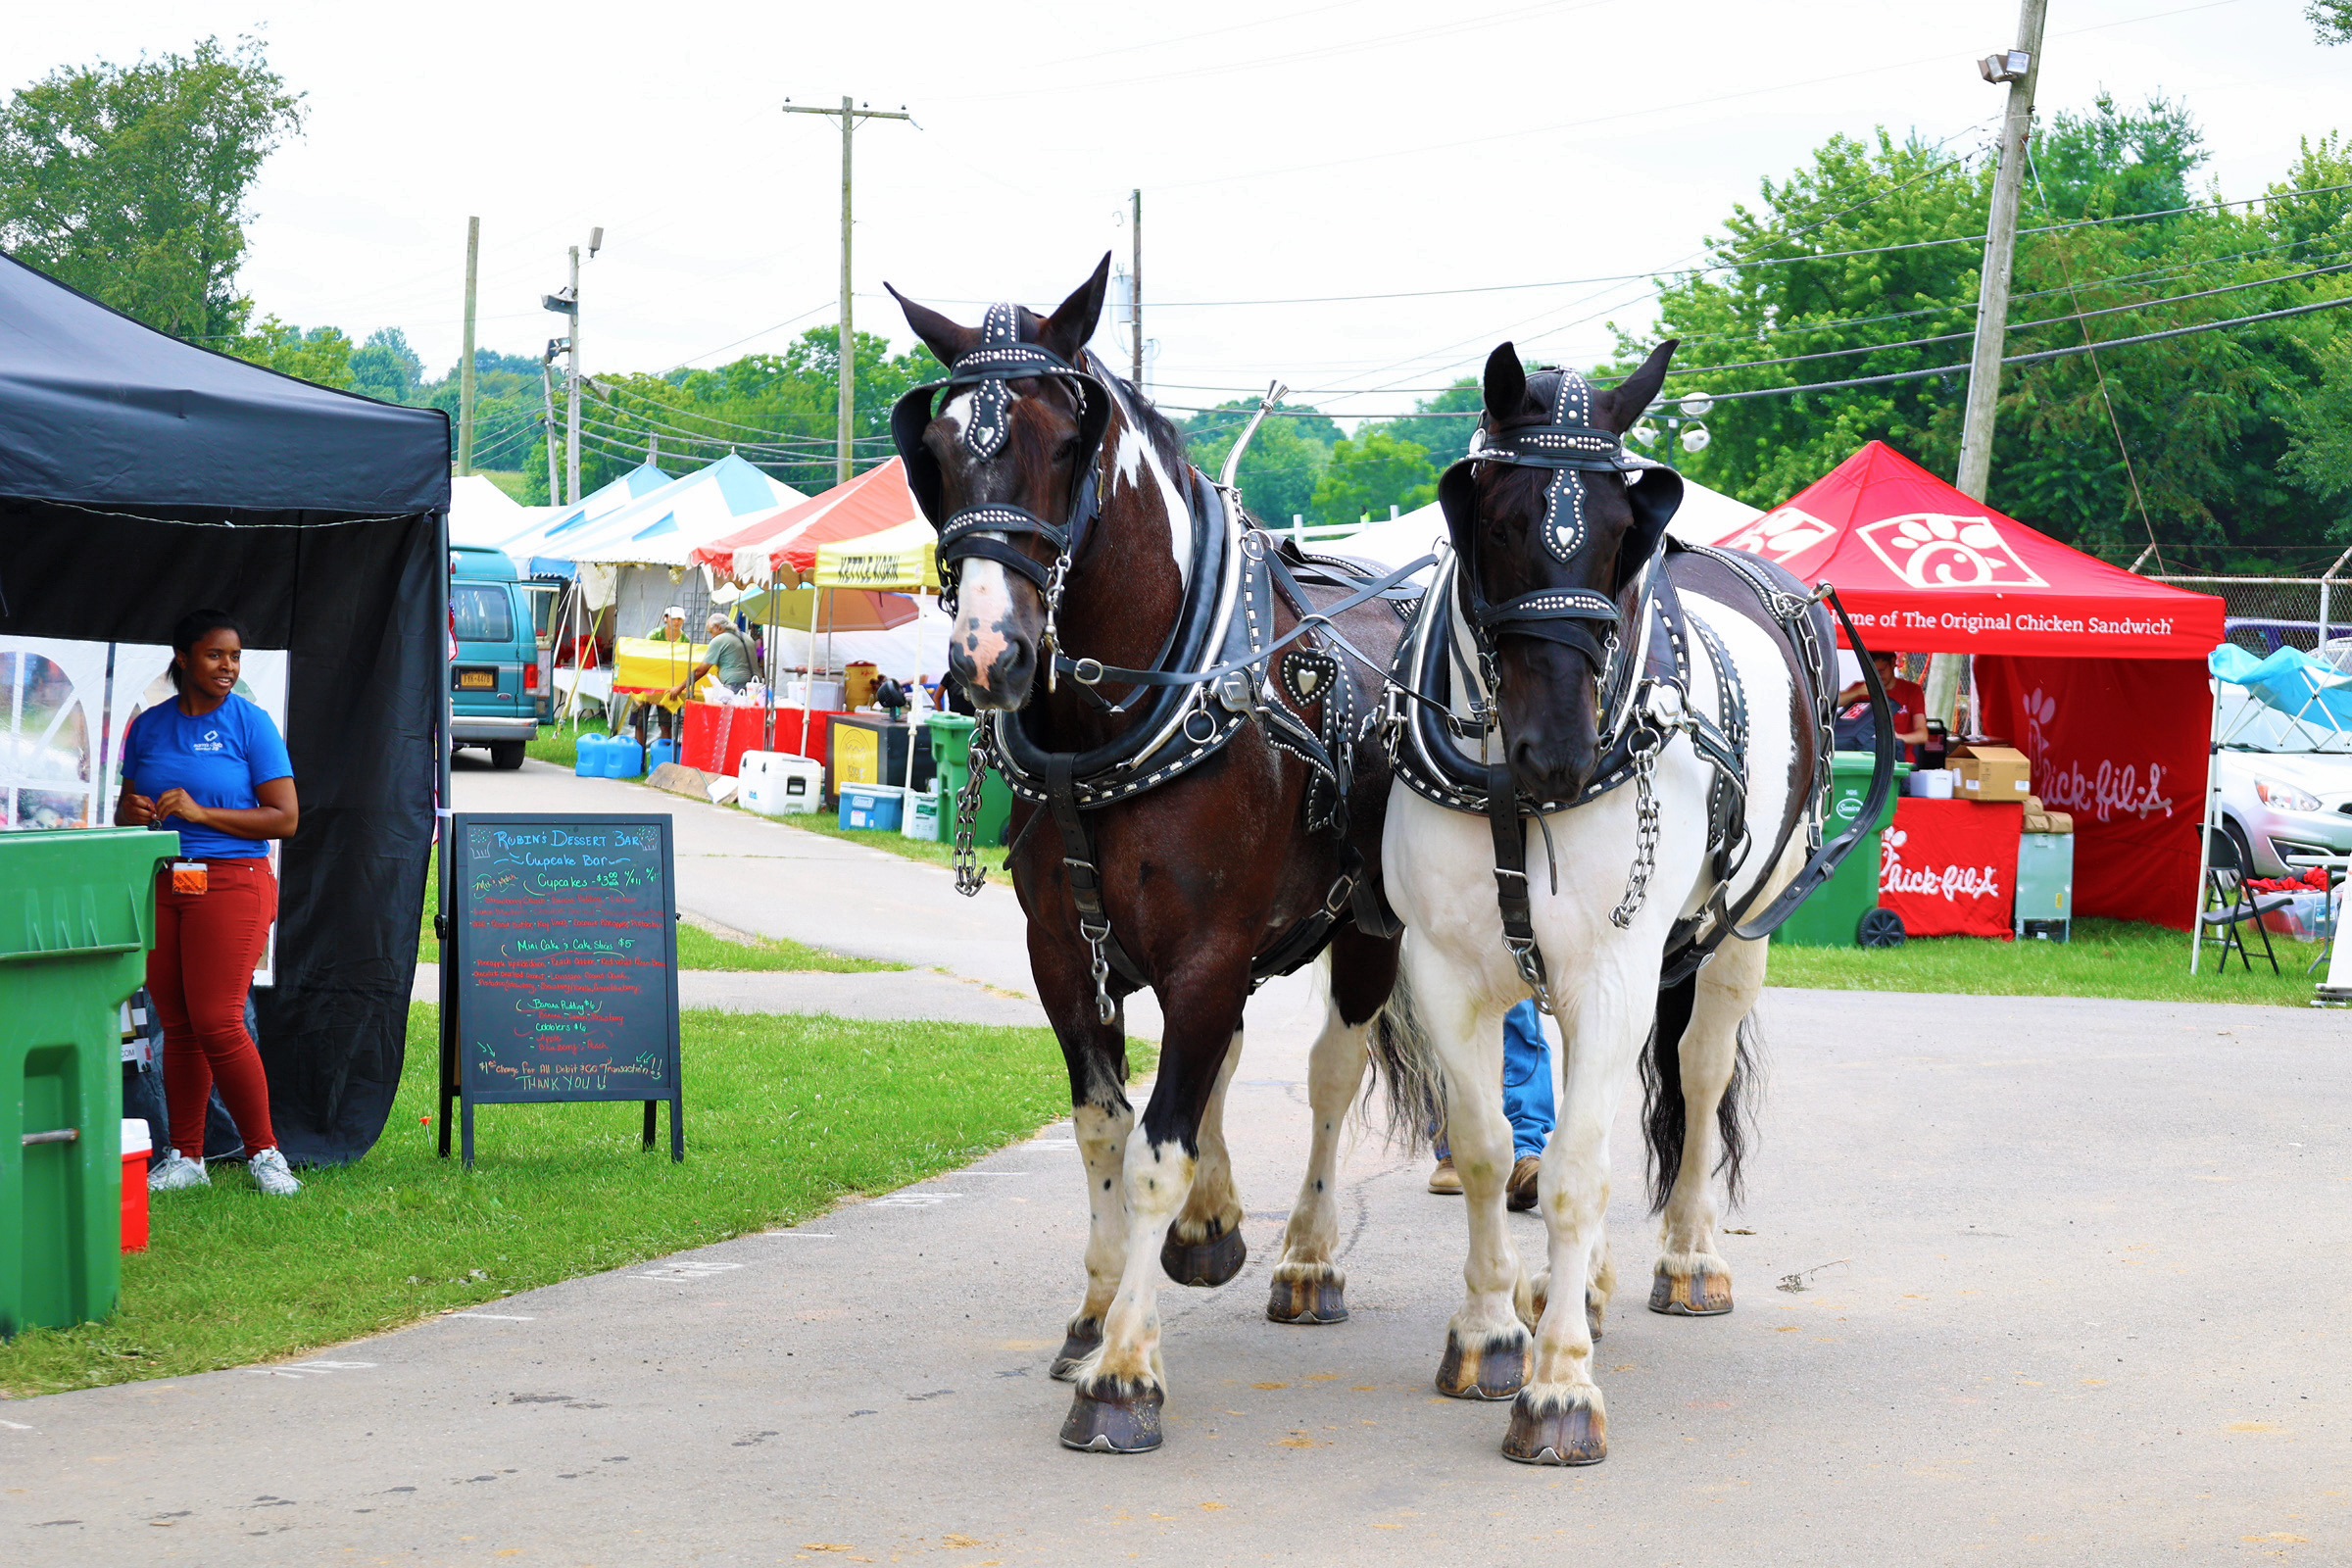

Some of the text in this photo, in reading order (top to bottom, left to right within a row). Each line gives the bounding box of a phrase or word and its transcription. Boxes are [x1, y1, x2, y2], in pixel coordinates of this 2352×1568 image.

[838, 555, 900, 583] KETTLE KORN
[1826, 609, 1875, 626] Hme
[1880, 610, 1899, 627] of
[1902, 611, 1937, 628] The
[1940, 612, 2011, 634] Original
[2015, 613, 2083, 633] Chicken
[551, 829, 607, 847] DESSERT
[525, 852, 608, 871] Cupcake Bar
[537, 872, 588, 891] Cupcakes
[516, 939, 539, 951] Mini
[540, 938, 560, 950] Cake
[572, 937, 592, 950] Cake
[593, 939, 613, 950] Slices
[617, 937, 635, 948] $5
[532, 998, 560, 1009] Banana
[561, 998, 584, 1014] Pudding
[535, 1022, 570, 1032] Cobblers
[515, 1074, 560, 1090] THANK
[563, 1074, 591, 1090] YOU
